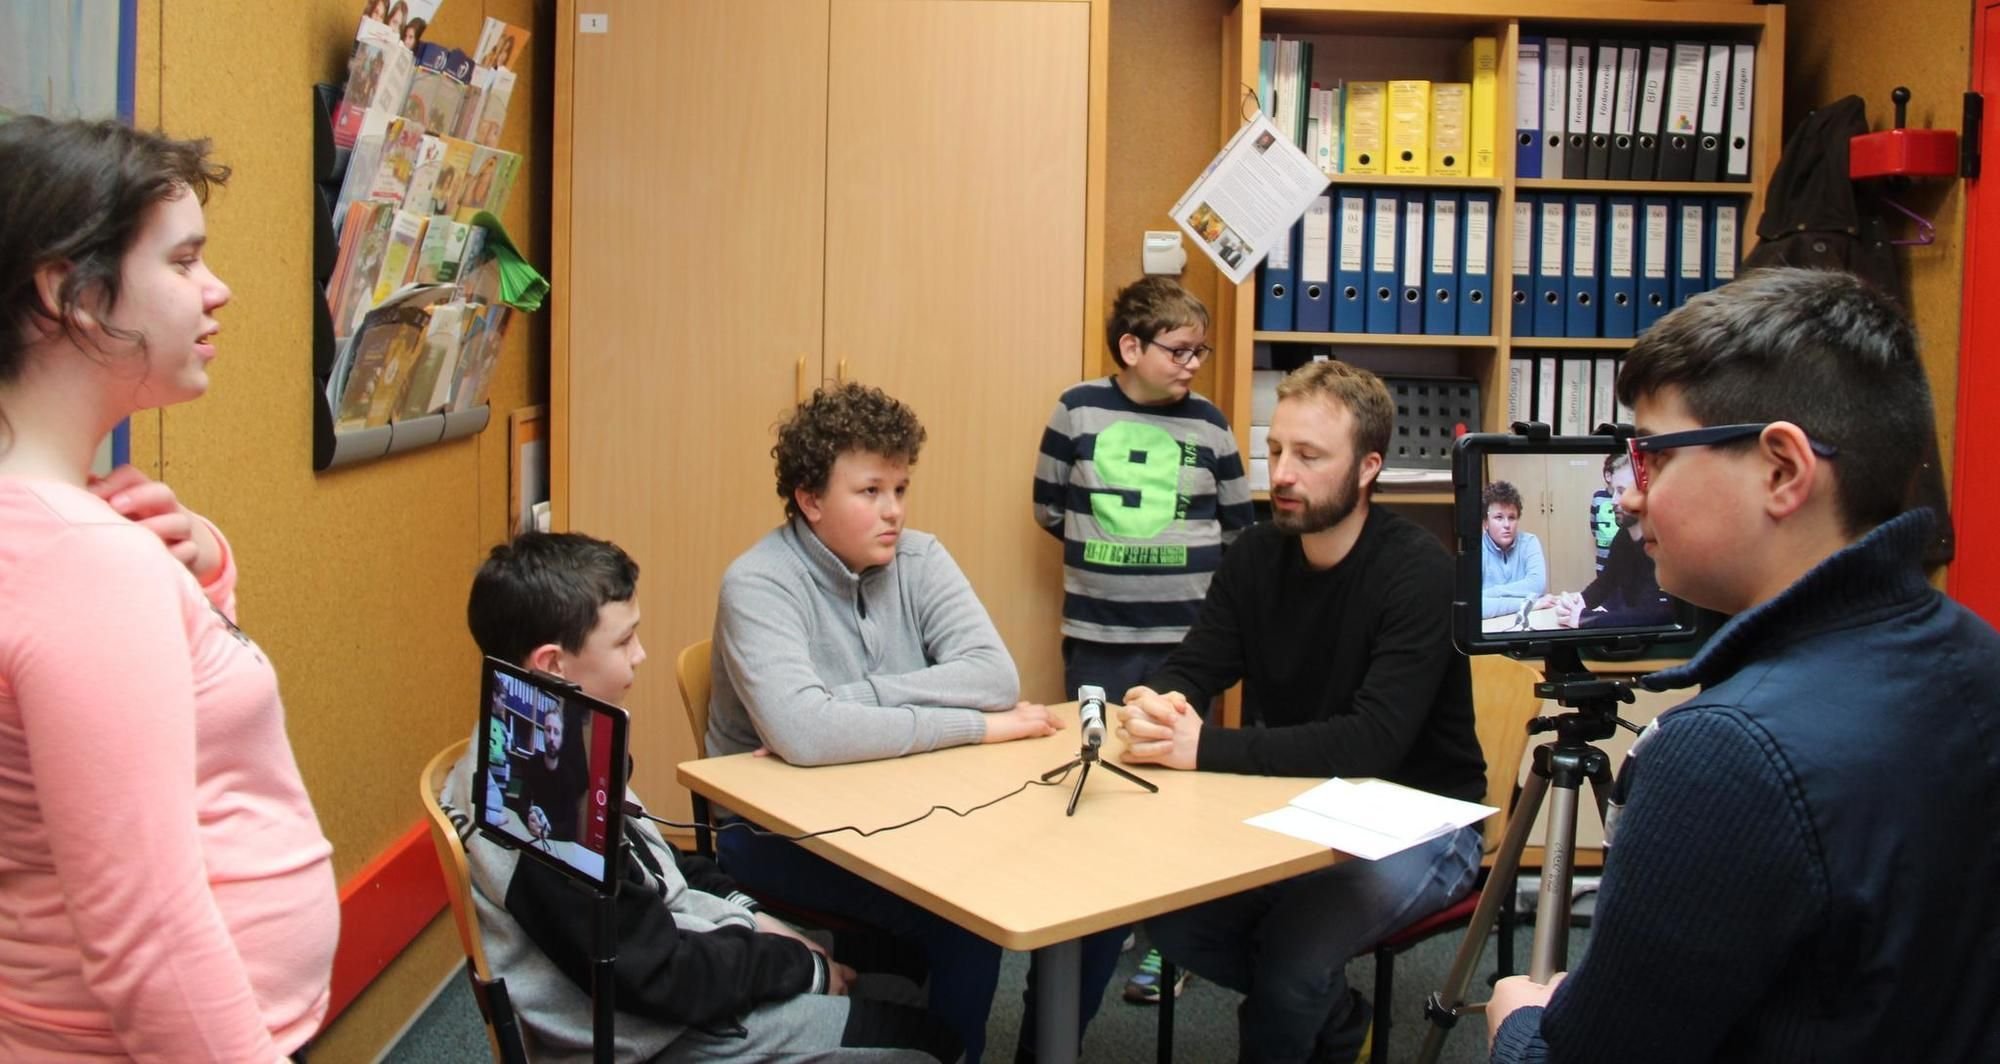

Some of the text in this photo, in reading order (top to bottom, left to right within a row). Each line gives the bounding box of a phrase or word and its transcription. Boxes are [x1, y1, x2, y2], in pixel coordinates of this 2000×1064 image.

[1575, 55, 1584, 123] Fremdevaluation
[1599, 64, 1611, 116] Förderverein
[1646, 80, 1658, 103] BFD
[1567, 380, 1578, 423] Seminar
[1090, 420, 1183, 539] 9
